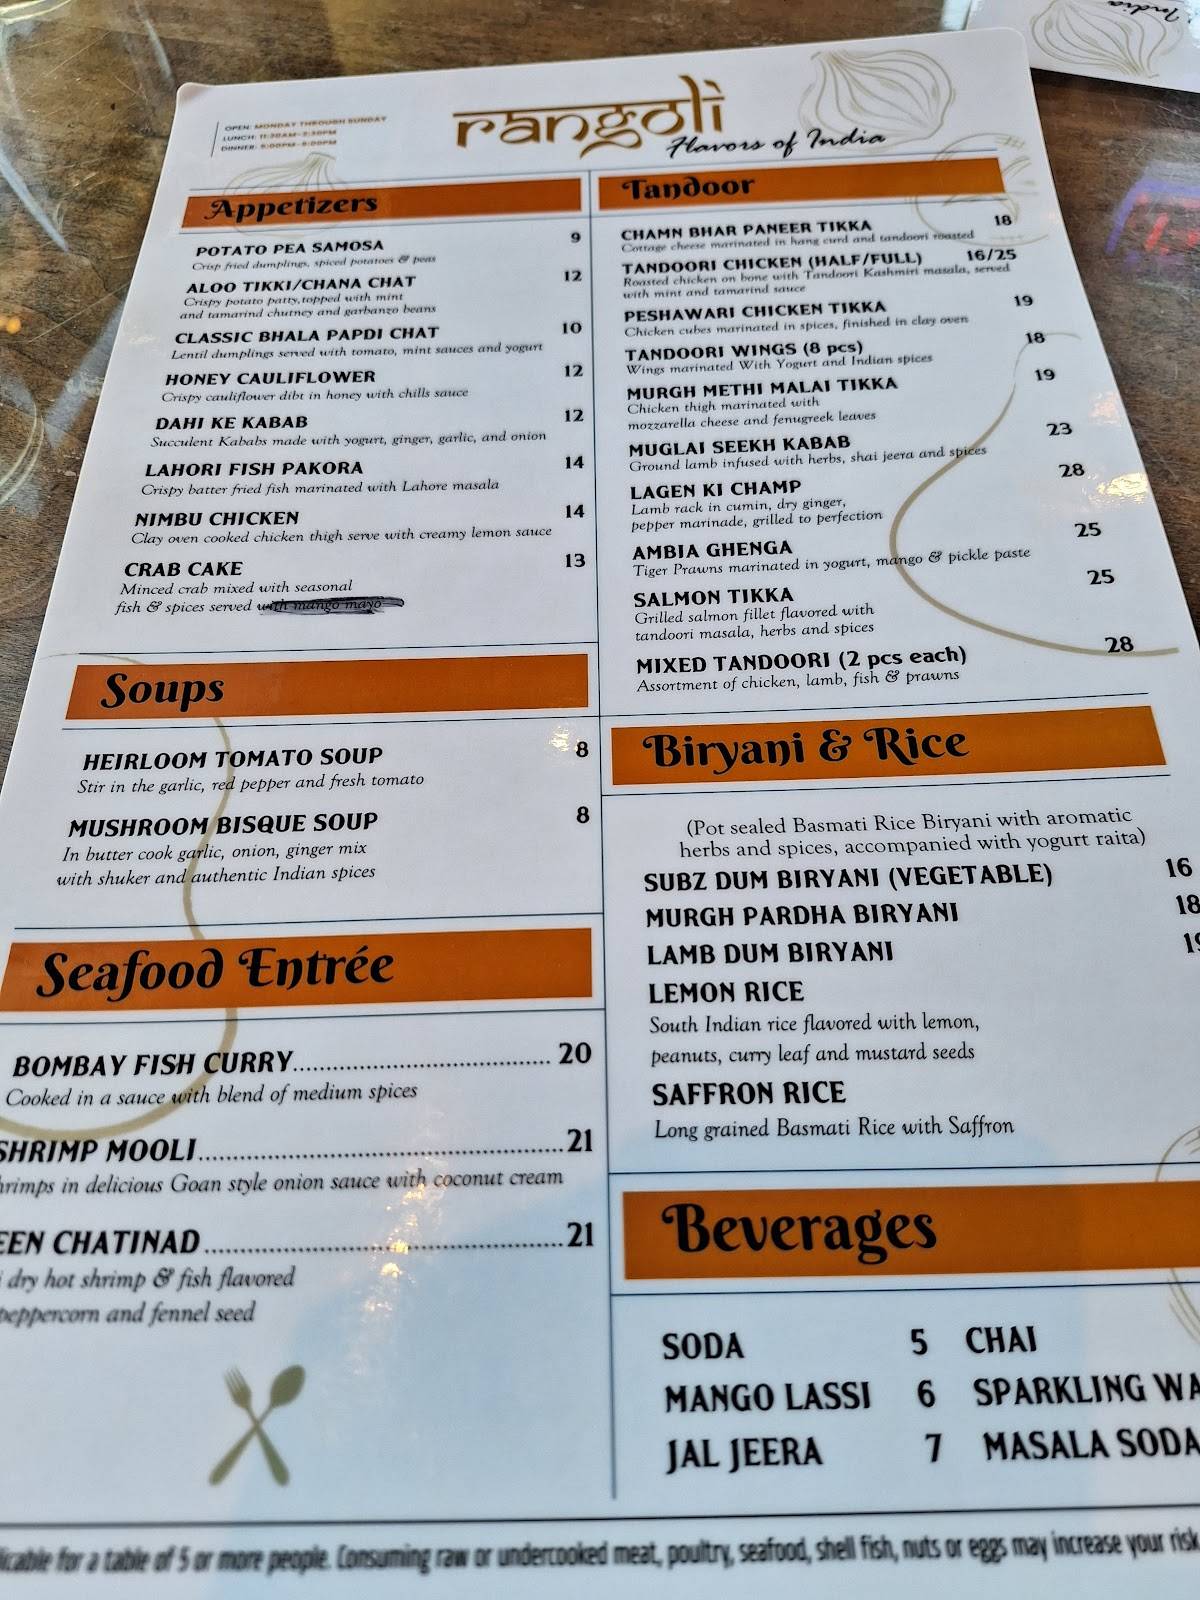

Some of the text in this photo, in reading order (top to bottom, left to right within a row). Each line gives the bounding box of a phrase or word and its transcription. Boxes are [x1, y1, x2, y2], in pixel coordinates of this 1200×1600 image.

[666, 127, 886, 158] Flavors of India
[622, 176, 754, 199] Tandoor
[204, 196, 378, 222] Appetizers
[621, 218, 873, 240] CHAMN BHAR PANEER TIKKA
[994, 215, 1012, 226] 18
[196, 240, 383, 256] POTATO PEA SAMOSA
[571, 232, 581, 243] 9
[622, 252, 922, 274] TANDOORI CHICKEN (HALF/FULL)
[967, 248, 1016, 261] 16/25
[186, 276, 416, 293] ALOO TIKKI/CHANA CHAT
[563, 269, 582, 282] 12
[624, 299, 887, 323] PESHAWARI CHICKEN TIKKA
[1014, 296, 1033, 306] 19
[175, 327, 439, 344] CLASSIC BHALA PAPDI CHAT
[563, 322, 582, 334] 10
[156, 416, 308, 430] DAHI KE KABAB
[565, 409, 584, 422] 12
[150, 431, 546, 447] Succulent Kababs made with yogurt, ginger, garlic, and onion
[1046, 422, 1072, 436] 23
[629, 436, 850, 457] MUGLAI SEEKH KABAB
[146, 462, 363, 476] LAHORI FISH PAKORA
[566, 456, 584, 469] 14
[1059, 464, 1085, 478] 28
[630, 480, 801, 499] LAGEN KI CHAMP
[135, 512, 299, 526] NIMBU CHICKEN
[566, 504, 584, 518] 14
[125, 562, 243, 576] CRAB CAKE
[566, 554, 585, 567] 13
[633, 548, 1030, 578] Tiger Prawns marinated in yogurt, mango & pickle paste
[120, 580, 352, 594] Minced crab mixed with seasonal
[1087, 569, 1114, 584] 25
[634, 587, 794, 607] SALMON TIKKA
[1105, 636, 1134, 653] 28
[636, 646, 966, 675] MIXED TANDOORI (2 pcs each)
[101, 673, 224, 712] Soups
[83, 747, 382, 770] HEIRLOOM TOMATO SOUP
[576, 741, 588, 758] 8
[643, 727, 970, 775] Biryani & Rice
[78, 773, 424, 795] Stir in the garlic, red pepper and fresh tomato
[68, 812, 378, 837] MUSHROOM BISQUE SOUP
[576, 806, 590, 824] 8
[646, 902, 960, 927] MURGH PARDHA BIRYANI
[1176, 894, 1200, 914] 18
[648, 941, 893, 965] LAMB DUM BIRYANI
[36, 945, 394, 1002] Seafood Entrée
[649, 981, 804, 1004] LEMON RICE
[13, 1051, 294, 1077] BOMBAY FISH CURRY
[560, 1042, 591, 1064] 20
[652, 1081, 846, 1106] SAFFRON RICE
[106, 1138, 196, 1162] MOOLI
[567, 1129, 594, 1152] 21
[662, 1204, 936, 1264] Beverages
[662, 1332, 744, 1360] SODA
[911, 1328, 928, 1355] 5
[966, 1326, 1036, 1354] CHAI
[665, 1382, 870, 1412] MANGO LASSI
[918, 1380, 936, 1408] 6
[973, 1373, 1146, 1408] SPARKLING
[926, 1434, 942, 1462] 7
[983, 1427, 1200, 1460] MASALA SODA
[666, 1437, 823, 1474] JAL JEERA
[614, 1535, 1007, 1569] meat, poultry, seafood, shell fish, nuts or eggs
